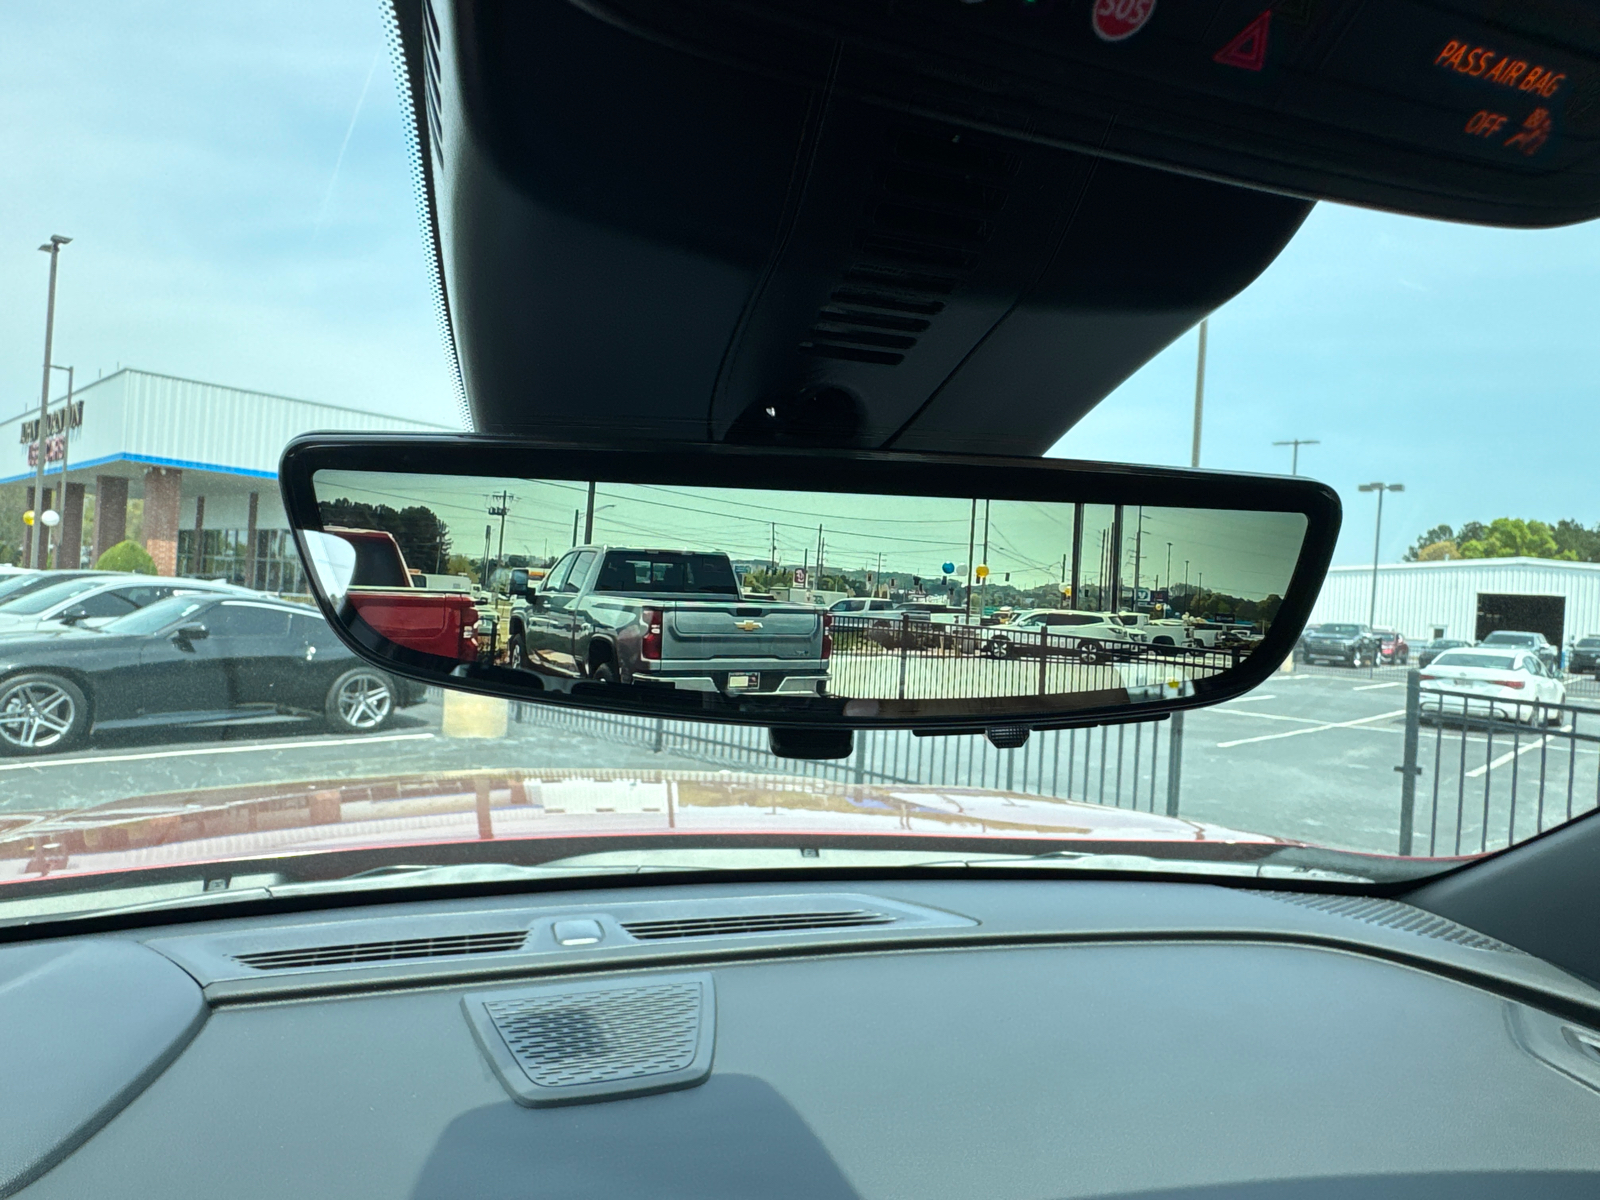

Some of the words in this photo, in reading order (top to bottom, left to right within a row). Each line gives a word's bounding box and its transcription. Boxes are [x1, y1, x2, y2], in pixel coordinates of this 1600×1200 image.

[1098, 0, 1150, 23] SOS
[1433, 40, 1495, 76] PASS
[1483, 57, 1527, 86] AIR
[1518, 65, 1566, 98] BAG
[1464, 110, 1508, 137] OFF
